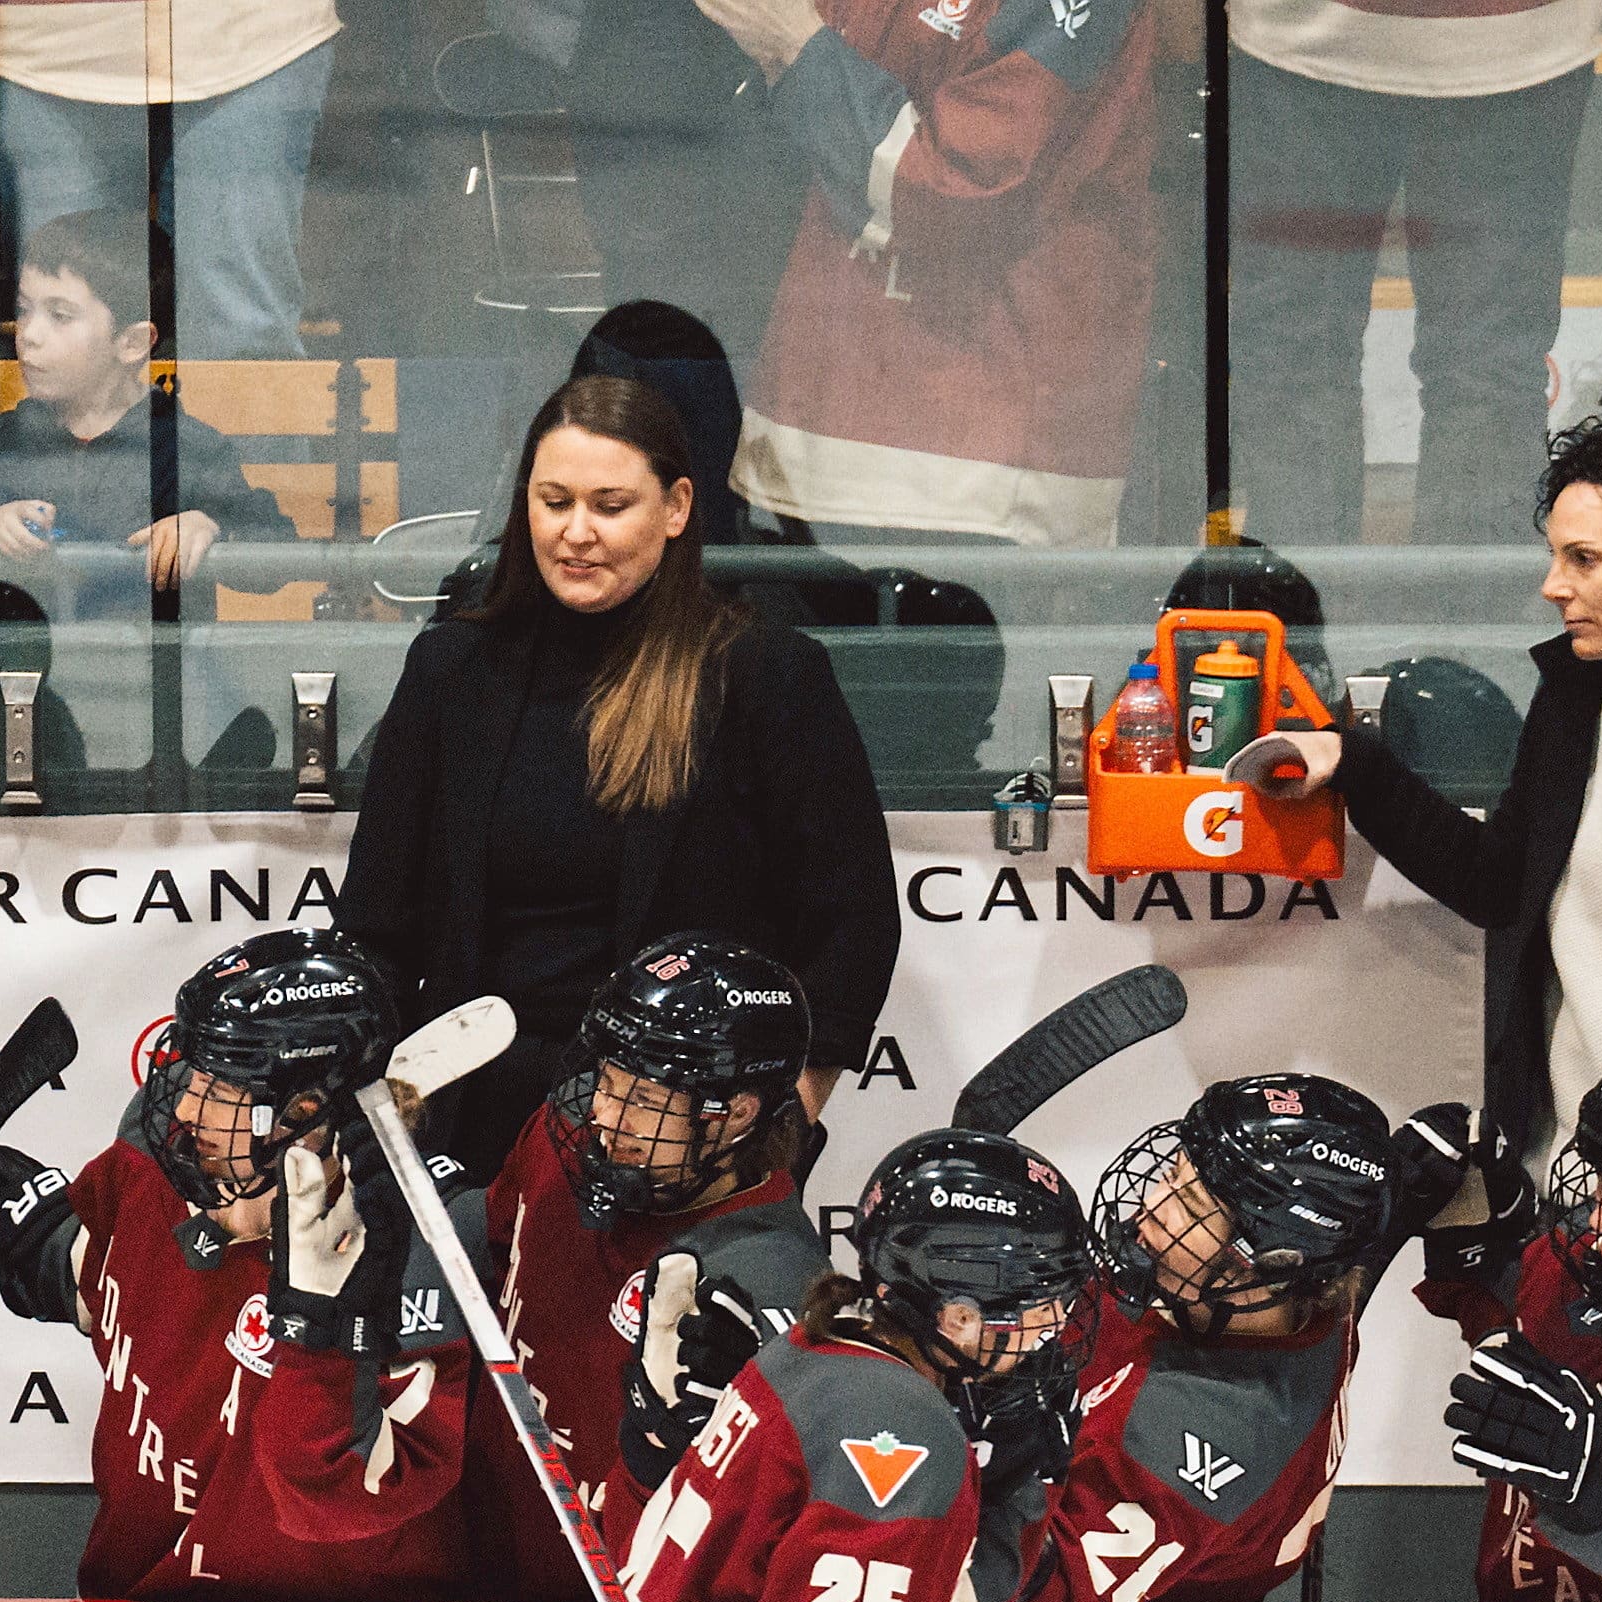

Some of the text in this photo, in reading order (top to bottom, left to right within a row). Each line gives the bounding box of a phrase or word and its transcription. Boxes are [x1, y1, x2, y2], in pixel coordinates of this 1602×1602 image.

[61, 866, 341, 923] CANA
[906, 866, 1341, 923] CANADA
[286, 982, 352, 1002] ROGERS
[645, 954, 793, 1005] 16 ROGERS
[1329, 1148, 1386, 1182] ROGERS
[950, 1192, 1018, 1217] ROGERS
[98, 1235, 221, 1581] ONTRÉL
